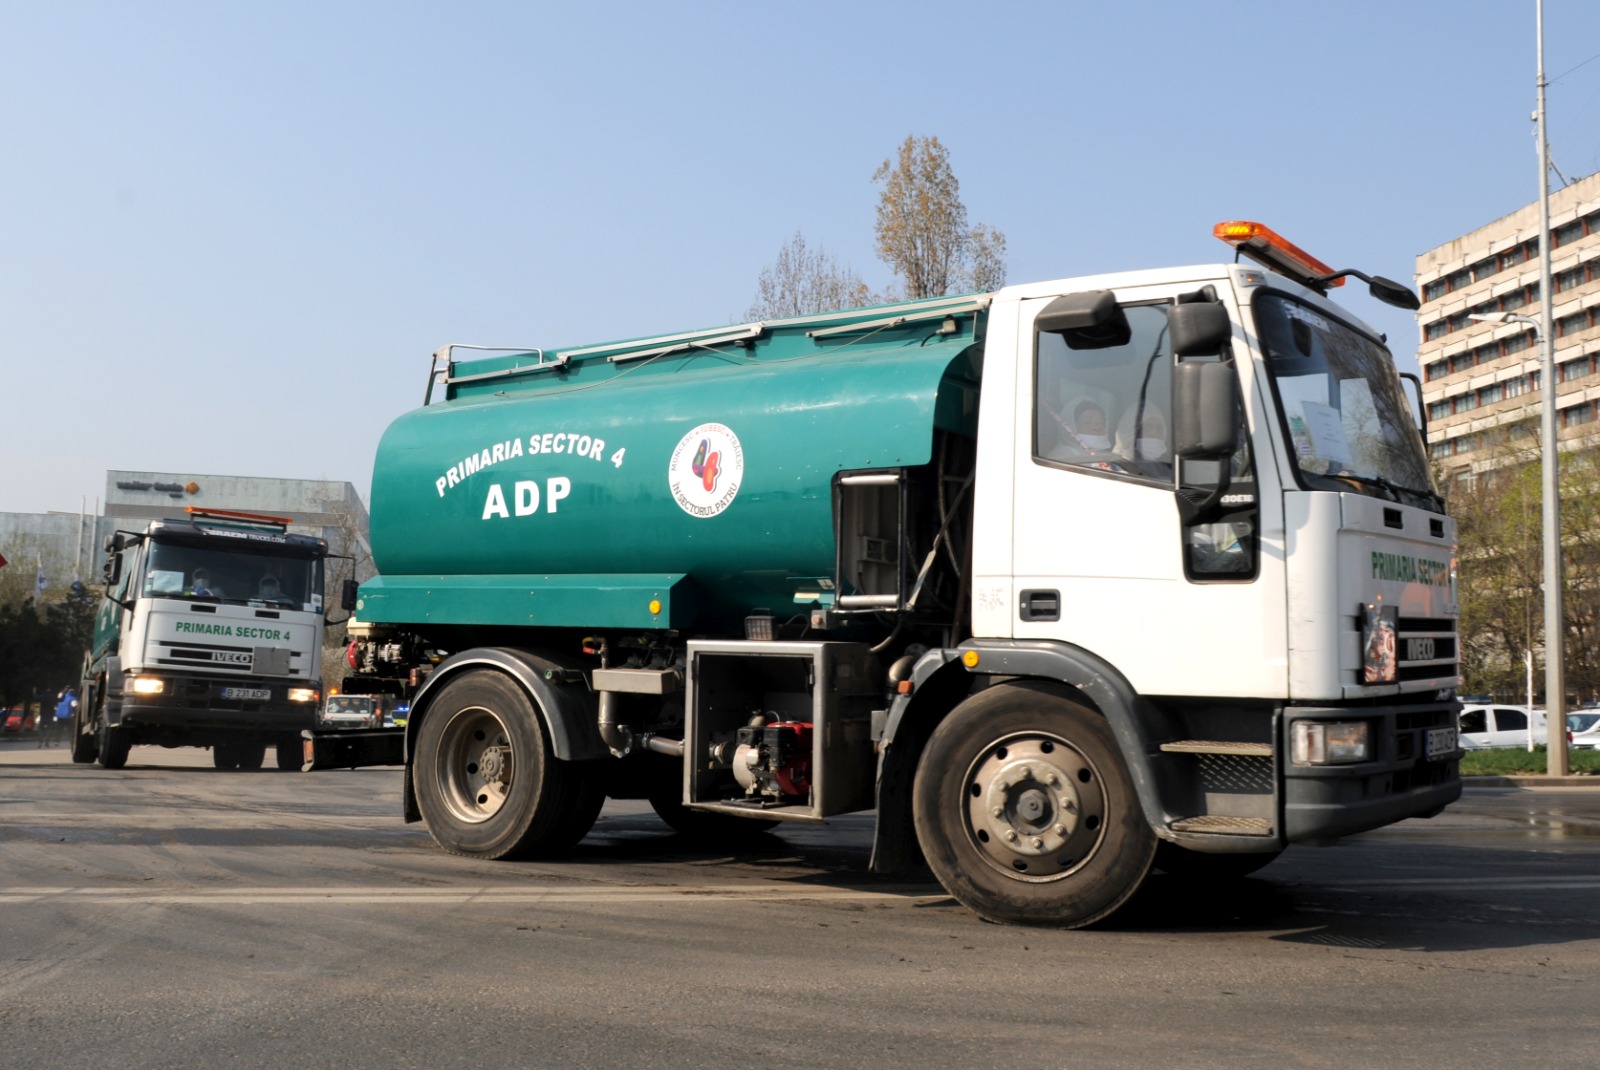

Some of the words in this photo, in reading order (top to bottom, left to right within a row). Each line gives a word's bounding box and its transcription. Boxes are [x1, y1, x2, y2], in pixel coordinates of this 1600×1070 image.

[435, 438, 523, 498] PRIMARIA
[528, 433, 605, 462] SECTOR
[610, 447, 626, 469] 4
[671, 433, 694, 472] MUNCESC
[481, 476, 571, 520] ADP
[677, 493, 716, 516] SECTORUL
[714, 482, 738, 512] PATRU
[1371, 551, 1417, 582] PRIMARIA
[175, 621, 232, 636] PRIMARIA
[235, 626, 281, 641] SECTOR
[283, 631, 291, 641] 4
[211, 652, 251, 663] IVECO
[1407, 638, 1435, 660] IVECO
[226, 688, 233, 697] B
[251, 689, 269, 698] ADP
